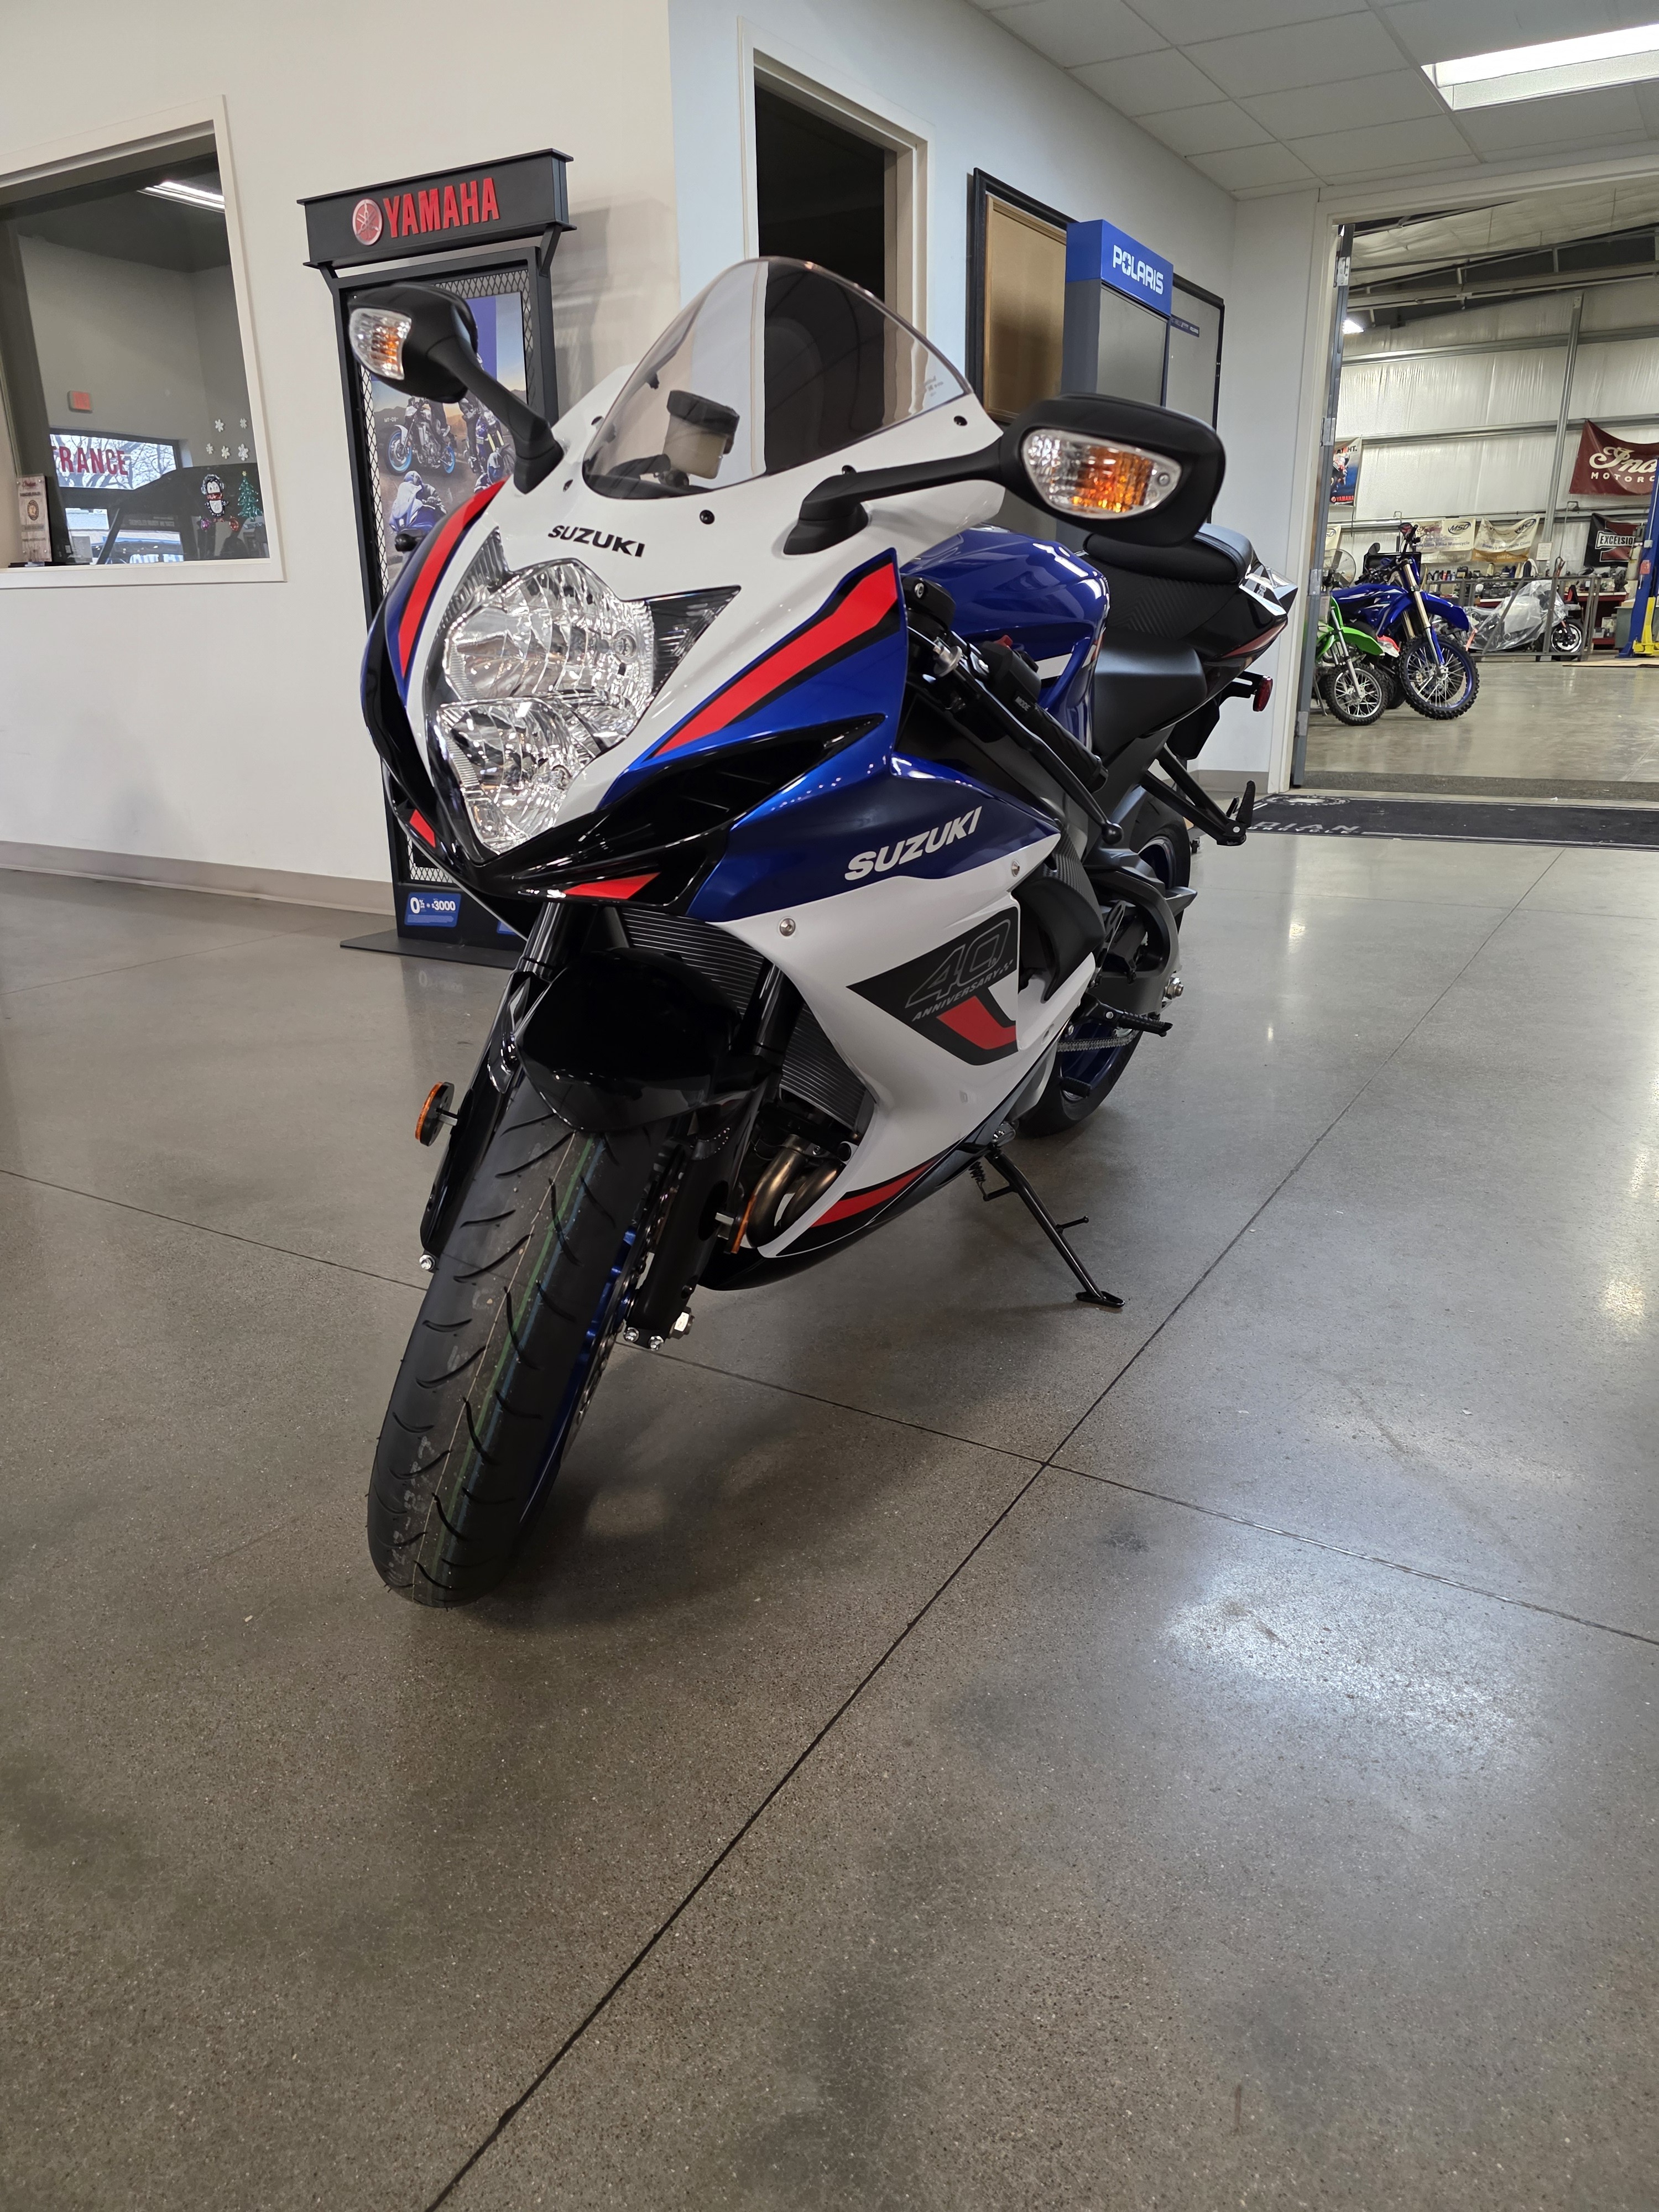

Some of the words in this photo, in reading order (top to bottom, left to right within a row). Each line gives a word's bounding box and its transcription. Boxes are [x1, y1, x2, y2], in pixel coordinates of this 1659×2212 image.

[383, 178, 499, 238] YAMAHA
[1113, 244, 1164, 295] POLARIS
[53, 446, 128, 476] RANCE
[1590, 472, 1655, 483] MOTORC
[548, 525, 645, 557] SUZUKI
[1449, 523, 1470, 531] MSD
[1014, 696, 1031, 711] MODE
[1254, 821, 1361, 832] DIAN
[844, 806, 982, 880] SUZUKI
[905, 919, 1011, 1009] 40
[912, 967, 1001, 1022] ANNIVERSARY
